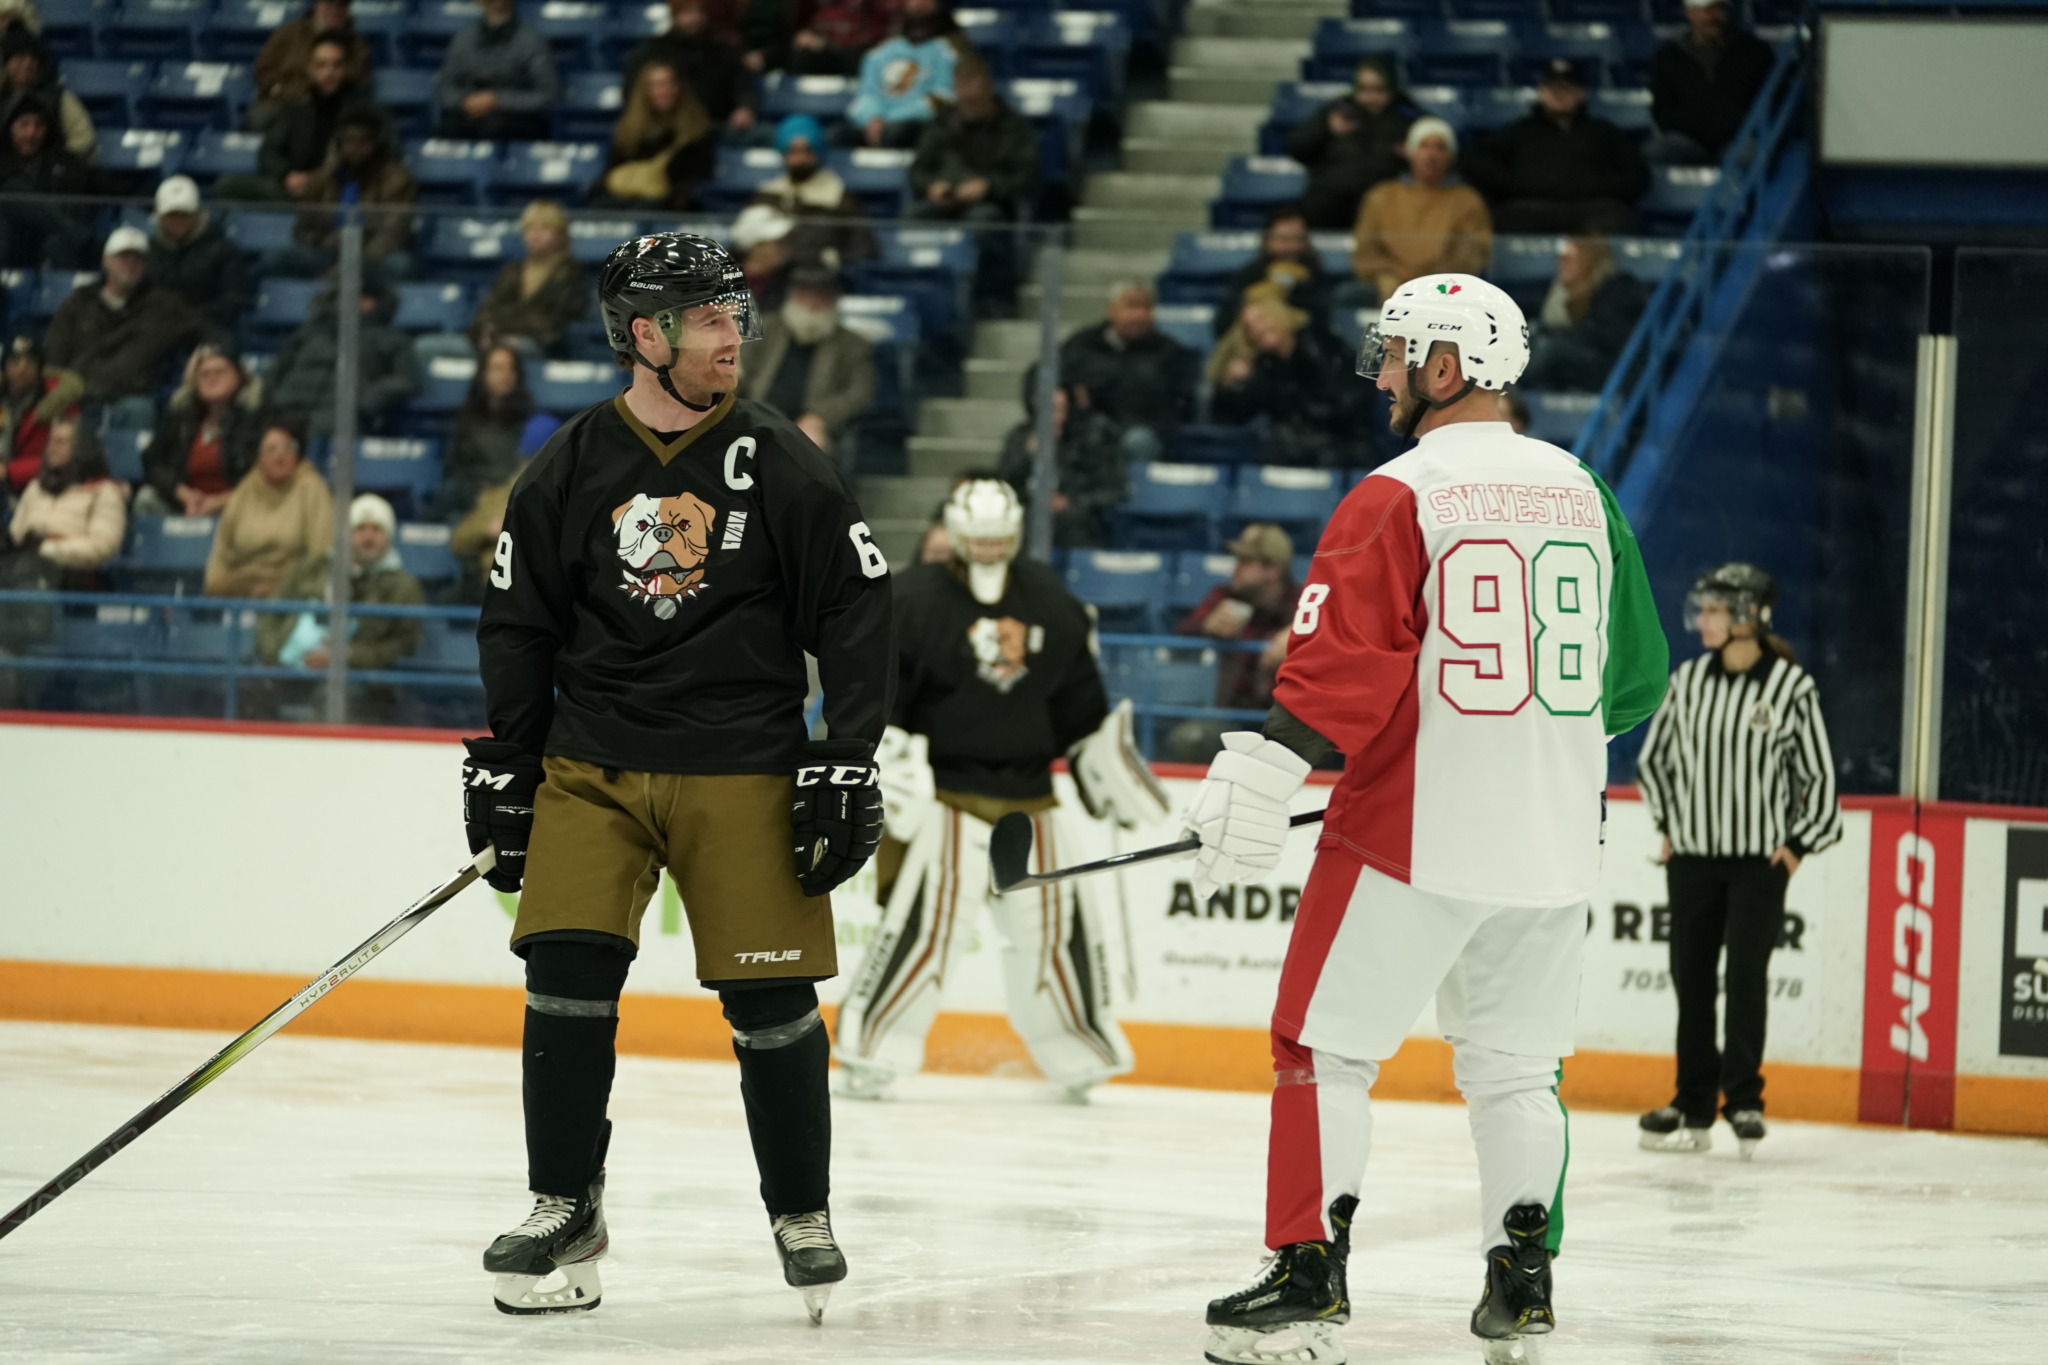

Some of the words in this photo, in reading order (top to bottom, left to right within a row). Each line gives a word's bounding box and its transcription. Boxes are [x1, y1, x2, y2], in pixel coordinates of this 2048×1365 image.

[629, 281, 664, 292] BAUER
[1427, 323, 1463, 332] CCM
[724, 436, 757, 491] C
[1428, 484, 1601, 528] SYLVESTRI
[490, 531, 514, 590] 9
[847, 521, 888, 579] 6
[1292, 583, 1331, 635] 8
[1438, 539, 1602, 717] 98
[733, 949, 802, 965] TRUE
[1890, 831, 1935, 1063] CCM
[300, 943, 381, 1008] HYP2RLITE
